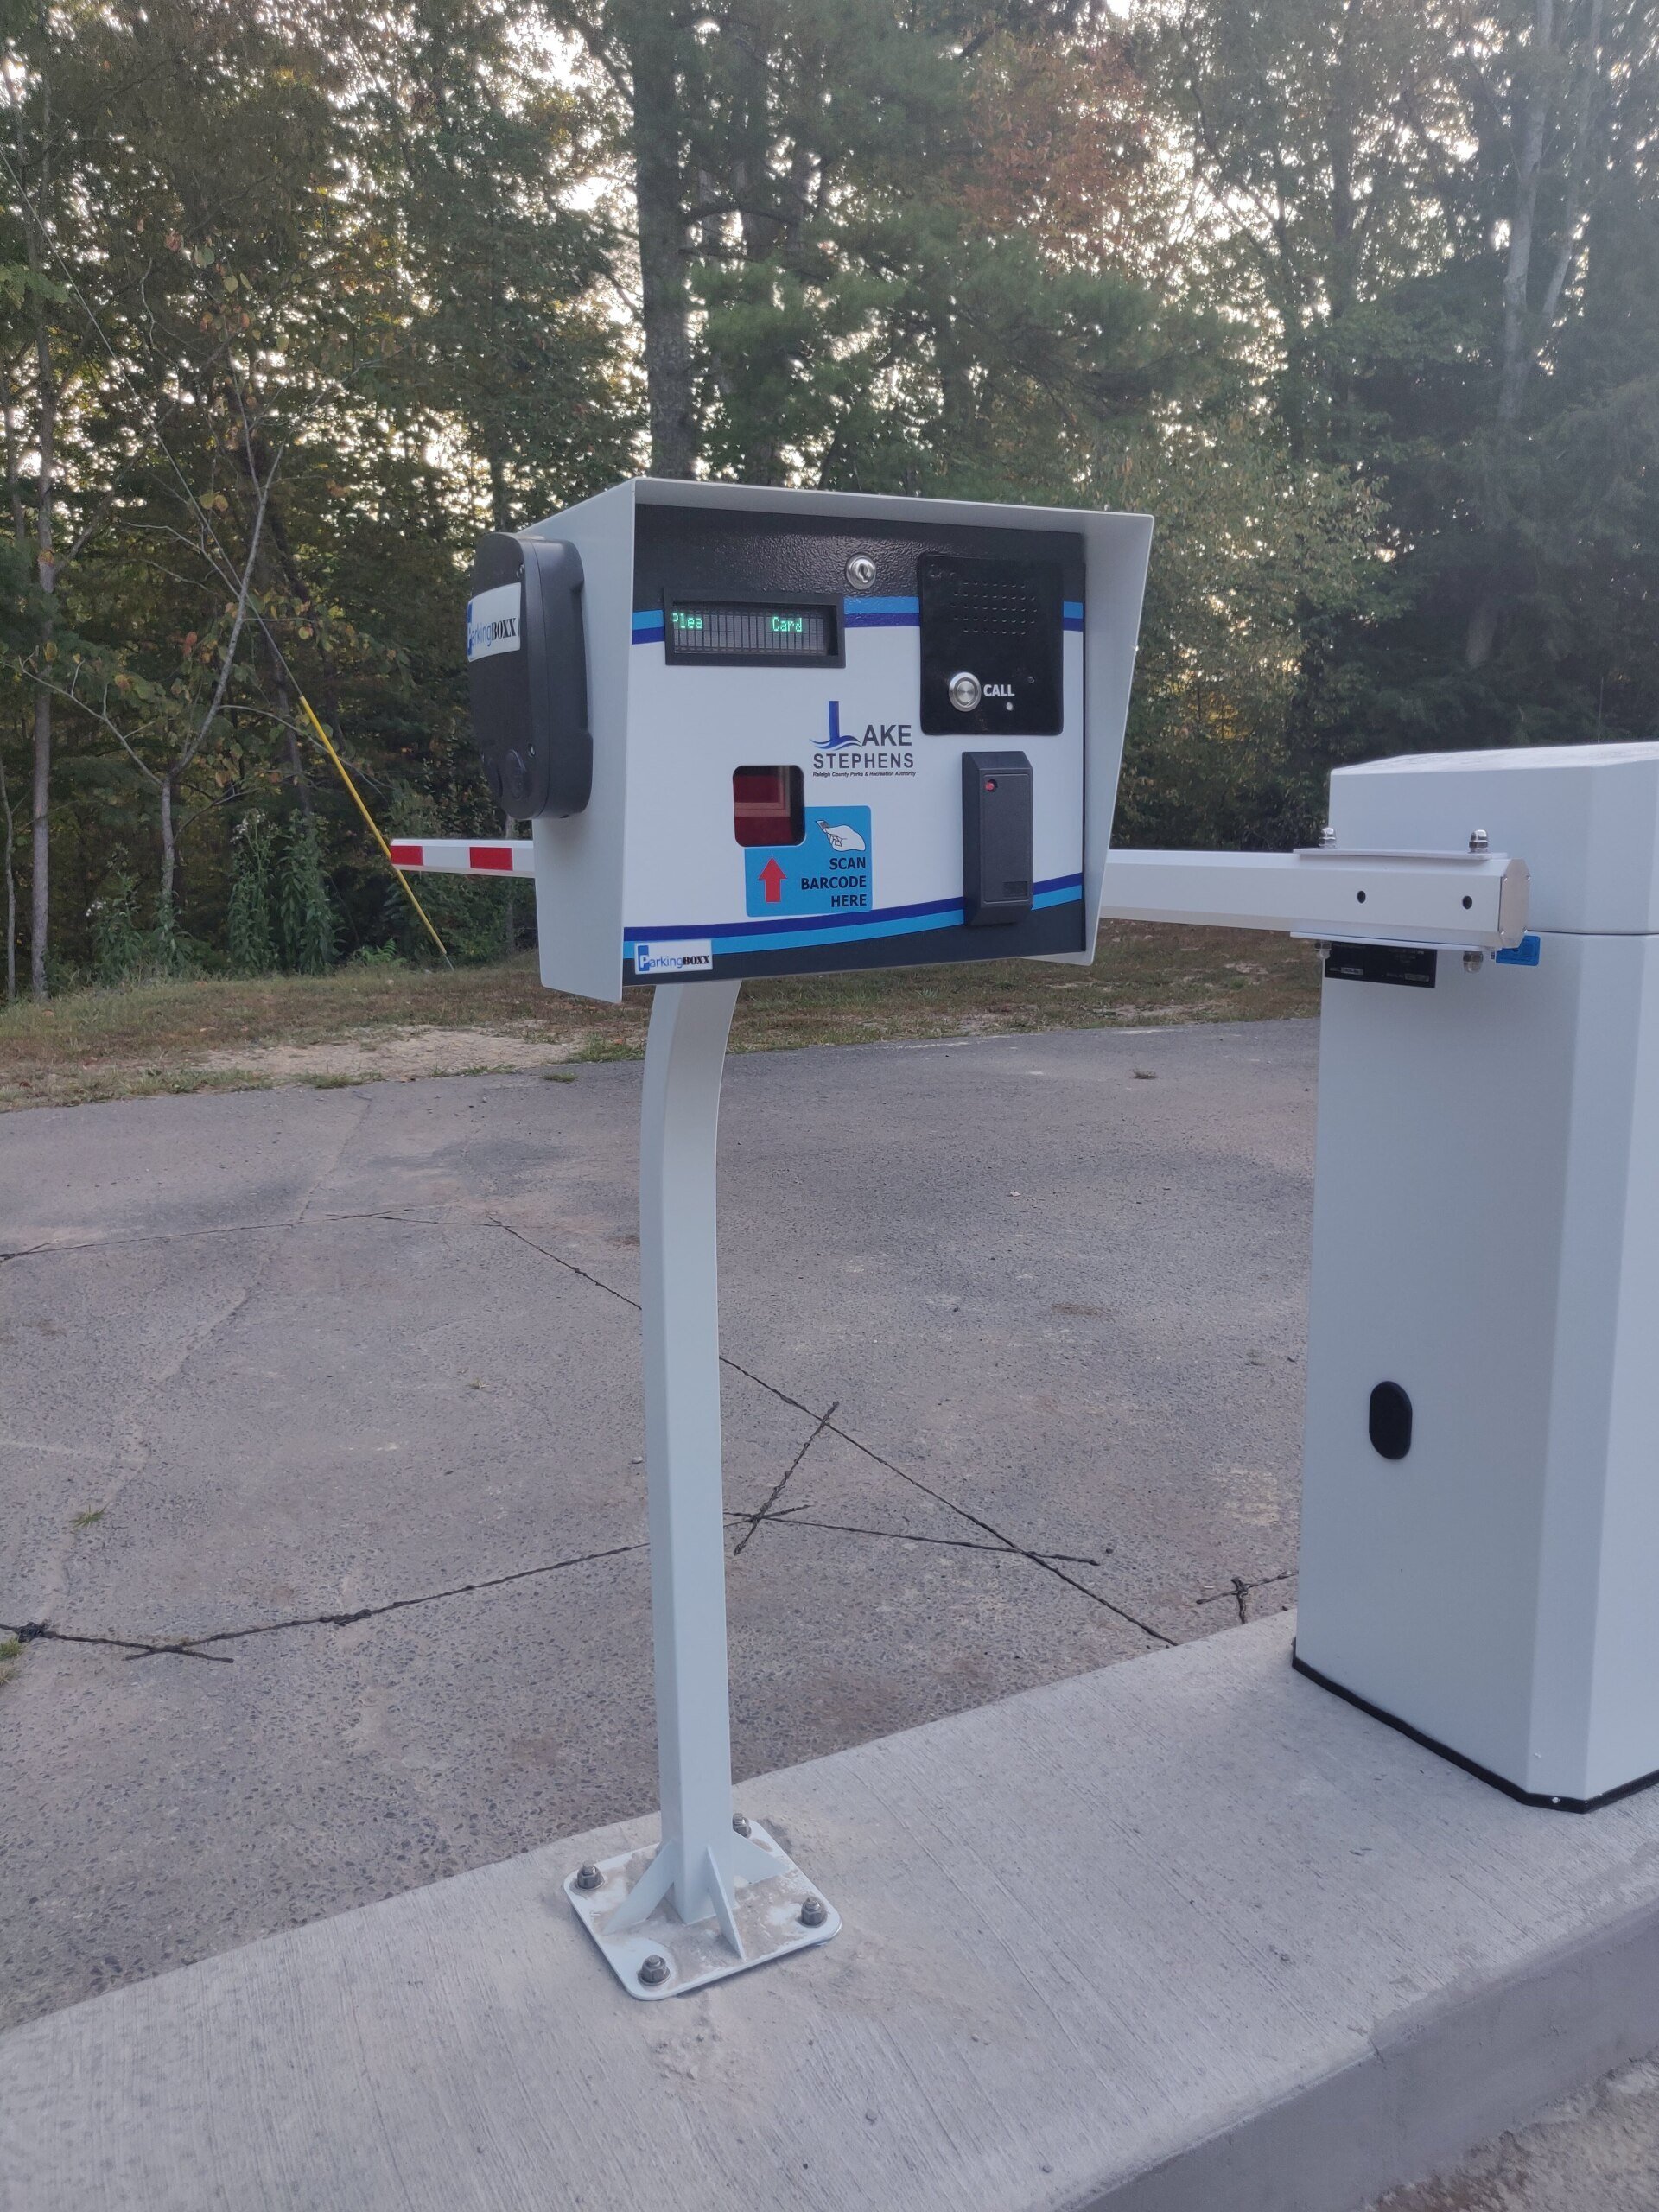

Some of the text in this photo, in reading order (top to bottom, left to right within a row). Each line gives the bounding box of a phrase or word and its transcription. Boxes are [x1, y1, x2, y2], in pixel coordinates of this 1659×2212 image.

[772, 617, 803, 632] Card
[983, 684, 1015, 697] CALL
[813, 753, 914, 769] STEPHENS
[830, 857, 866, 870] SCAN
[801, 875, 867, 890] BARCODE
[831, 893, 868, 907] HERE
[639, 955, 709, 969] ParkingBOXX
